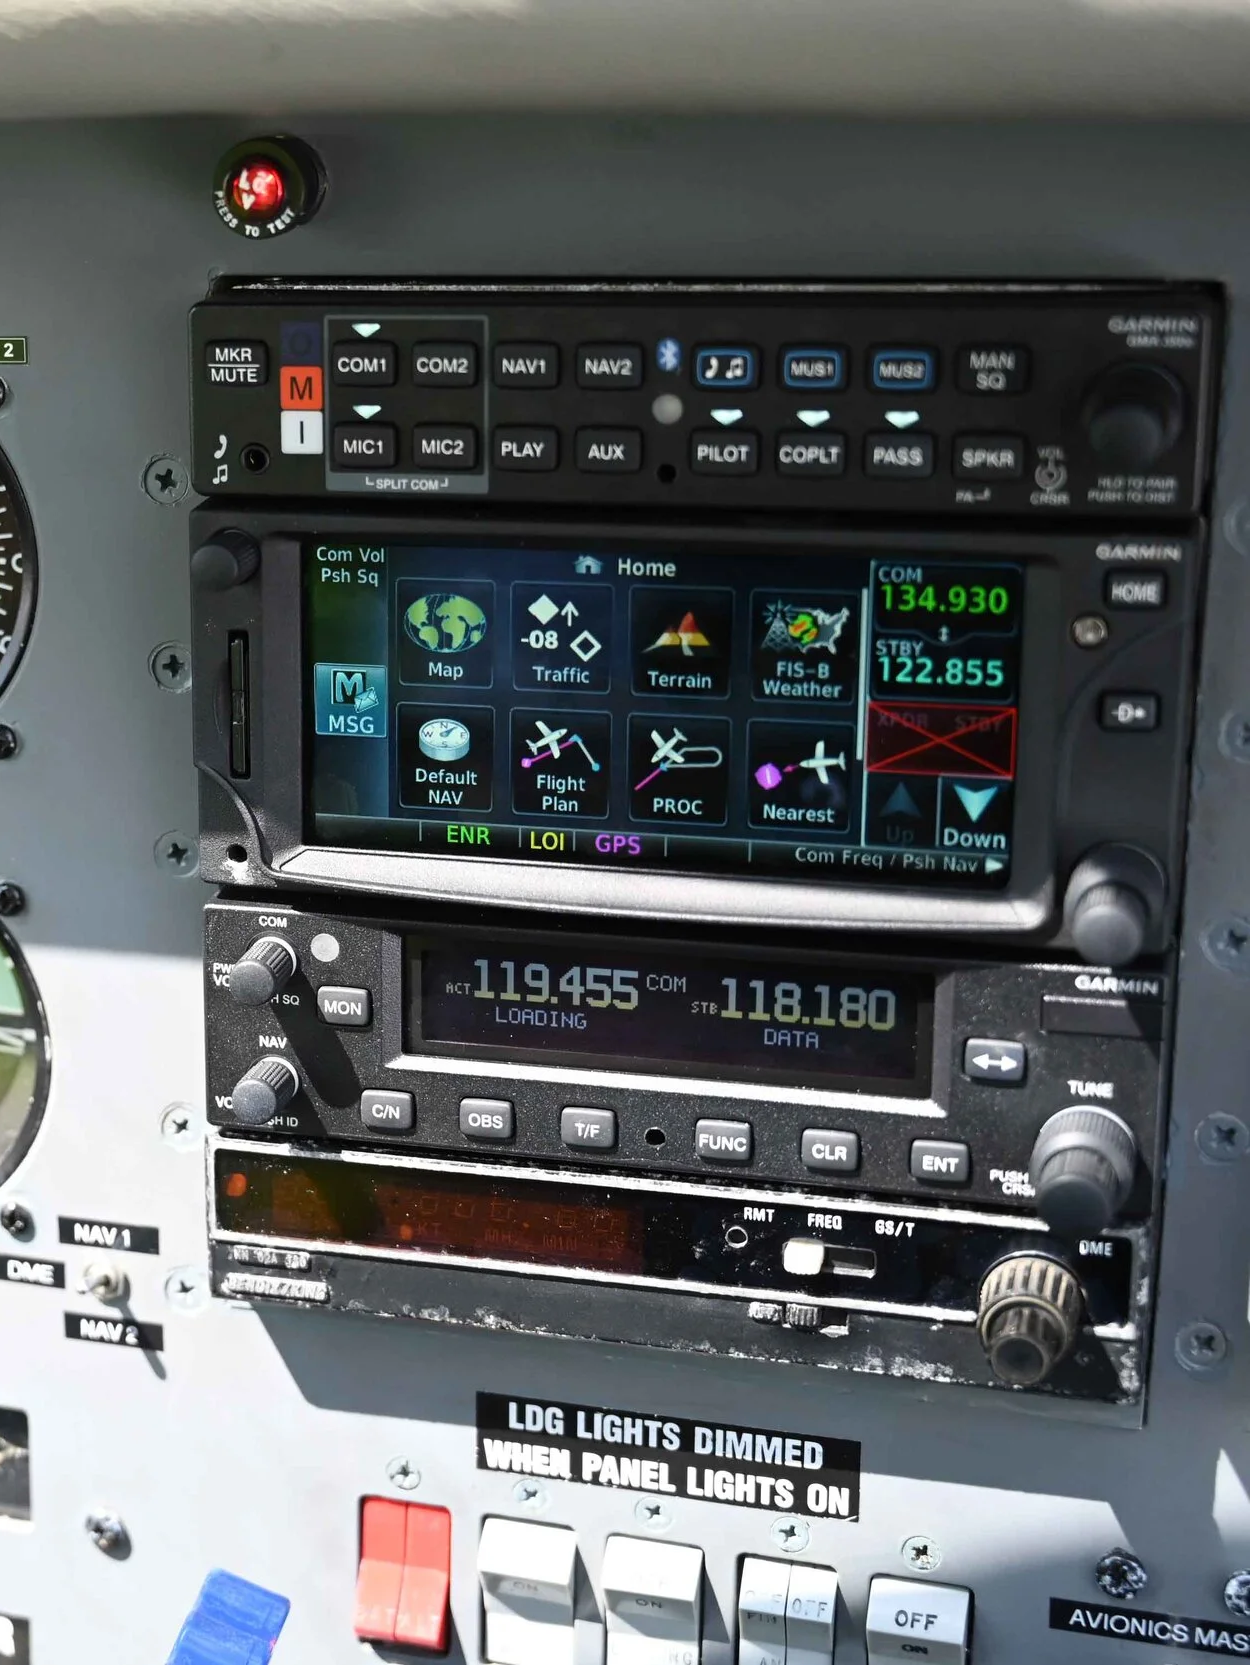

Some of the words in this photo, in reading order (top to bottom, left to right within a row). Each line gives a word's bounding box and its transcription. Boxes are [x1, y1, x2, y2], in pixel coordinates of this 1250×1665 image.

[214, 191, 238, 228] PRESS
[245, 225, 260, 237] TO
[267, 207, 295, 234] TEST
[1108, 315, 1197, 334] GARMIN
[4, 343, 14, 358] 2
[215, 348, 252, 362] MKR
[337, 357, 387, 374] COM1
[416, 357, 468, 374] COM2
[502, 358, 546, 375] NAV1
[585, 358, 632, 376] NAV2
[790, 361, 835, 377] MUS1
[969, 351, 1016, 370] MAN
[211, 368, 258, 382] MUTE
[879, 363, 925, 379] MUS2
[290, 376, 313, 400] M
[976, 372, 1006, 390] SQ
[343, 440, 384, 455] MIC1
[421, 440, 464, 456] MIC2
[501, 441, 545, 457] PLAY
[588, 444, 625, 460] AUX
[697, 445, 749, 462] PILOT
[779, 447, 839, 464] COPLT
[873, 448, 924, 466] PASS
[962, 450, 1016, 468] SPKR
[376, 478, 407, 491] SPLIT
[411, 479, 439, 491] COM
[317, 547, 352, 562] Com
[359, 548, 385, 563] Vol
[1096, 544, 1181, 561] GARMIN
[617, 558, 676, 577] Home
[878, 567, 922, 583] COM
[321, 568, 351, 583] Psh
[358, 570, 379, 587] Sq
[881, 584, 1008, 614] 134.930
[1111, 583, 1161, 604] HOME
[521, 631, 558, 650] -08
[876, 639, 923, 656] STBY
[428, 662, 463, 680] Map
[532, 666, 590, 684] Traffic
[777, 661, 830, 678] FIS-B
[878, 656, 1004, 686] 122.855
[648, 671, 712, 689] Terrain
[763, 680, 842, 698] Weather
[329, 715, 374, 733] MSG
[415, 768, 477, 786] Default
[537, 774, 586, 793] Flight
[429, 790, 463, 805] NAV
[542, 796, 579, 812] Plan
[653, 798, 703, 815] PROC
[763, 804, 835, 823] Nearest
[447, 825, 491, 845] ENR
[530, 831, 564, 850] LOI
[943, 828, 1006, 849] Down
[595, 834, 641, 855] GPS
[795, 848, 834, 864] Com
[842, 850, 882, 869] Freq
[903, 852, 935, 870] Psh
[943, 853, 979, 872] Nav
[259, 916, 287, 928] COM
[446, 982, 470, 994] ACT
[474, 959, 639, 1010] 119.455
[647, 975, 686, 992] COM
[1075, 975, 1158, 996] GARMIN
[282, 994, 299, 1006] SQ
[324, 1000, 361, 1015] MON
[691, 1002, 718, 1014] STB
[721, 978, 896, 1031] 118.180
[495, 1006, 587, 1029] LOADING
[259, 1035, 287, 1049] NAV
[764, 1029, 819, 1049] DATA
[1068, 1080, 1114, 1098] TUNE
[372, 1104, 400, 1120] C/N
[468, 1113, 503, 1128] OBS
[287, 1117, 299, 1127] ID
[575, 1123, 600, 1139] T/F
[699, 1134, 747, 1152] FUNC
[811, 1144, 846, 1161] CLR
[922, 1156, 959, 1172] ENT
[990, 1170, 1029, 1184] PUSH
[744, 1207, 775, 1222] RMT
[807, 1213, 842, 1230] FREQ
[74, 1222, 117, 1247] NAV
[120, 1230, 131, 1247] 1
[875, 1221, 915, 1237] GS/T
[1079, 1240, 1114, 1256] DME
[7, 1259, 55, 1284] DME
[80, 1319, 123, 1343] NAV
[125, 1326, 140, 1345] 2
[508, 1402, 565, 1436] LDG
[577, 1410, 680, 1451] LIGHTS
[695, 1426, 825, 1470] DIMMED
[484, 1438, 571, 1478] WHEN
[582, 1451, 676, 1493] PANEL
[687, 1466, 794, 1509] LIGHTS
[808, 1482, 850, 1516] ON
[894, 1609, 938, 1631] OFF
[1069, 1608, 1190, 1644] AVIONICS
[1194, 1626, 1250, 1653] MAS
[901, 1642, 929, 1656] ON
